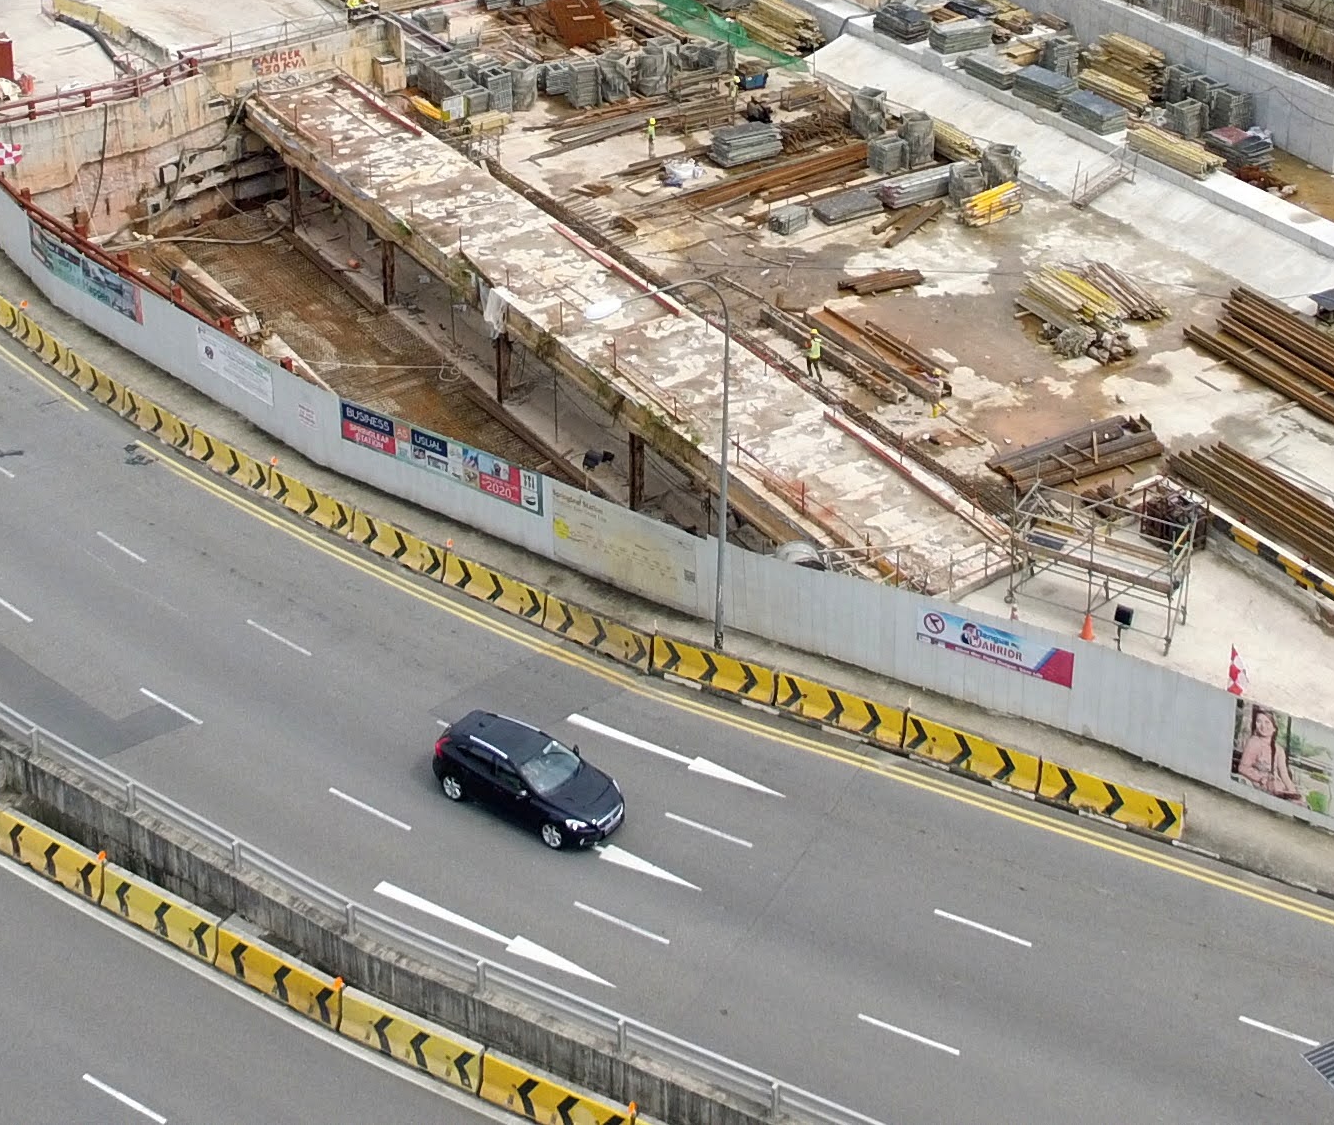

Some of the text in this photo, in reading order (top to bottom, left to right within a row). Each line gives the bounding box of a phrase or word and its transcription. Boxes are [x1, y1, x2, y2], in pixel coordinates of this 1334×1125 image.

[252, 49, 300, 67] DANGER
[346, 406, 390, 432] BUSINESS
[414, 433, 443, 452] USUAL
[486, 480, 513, 499] 2020
